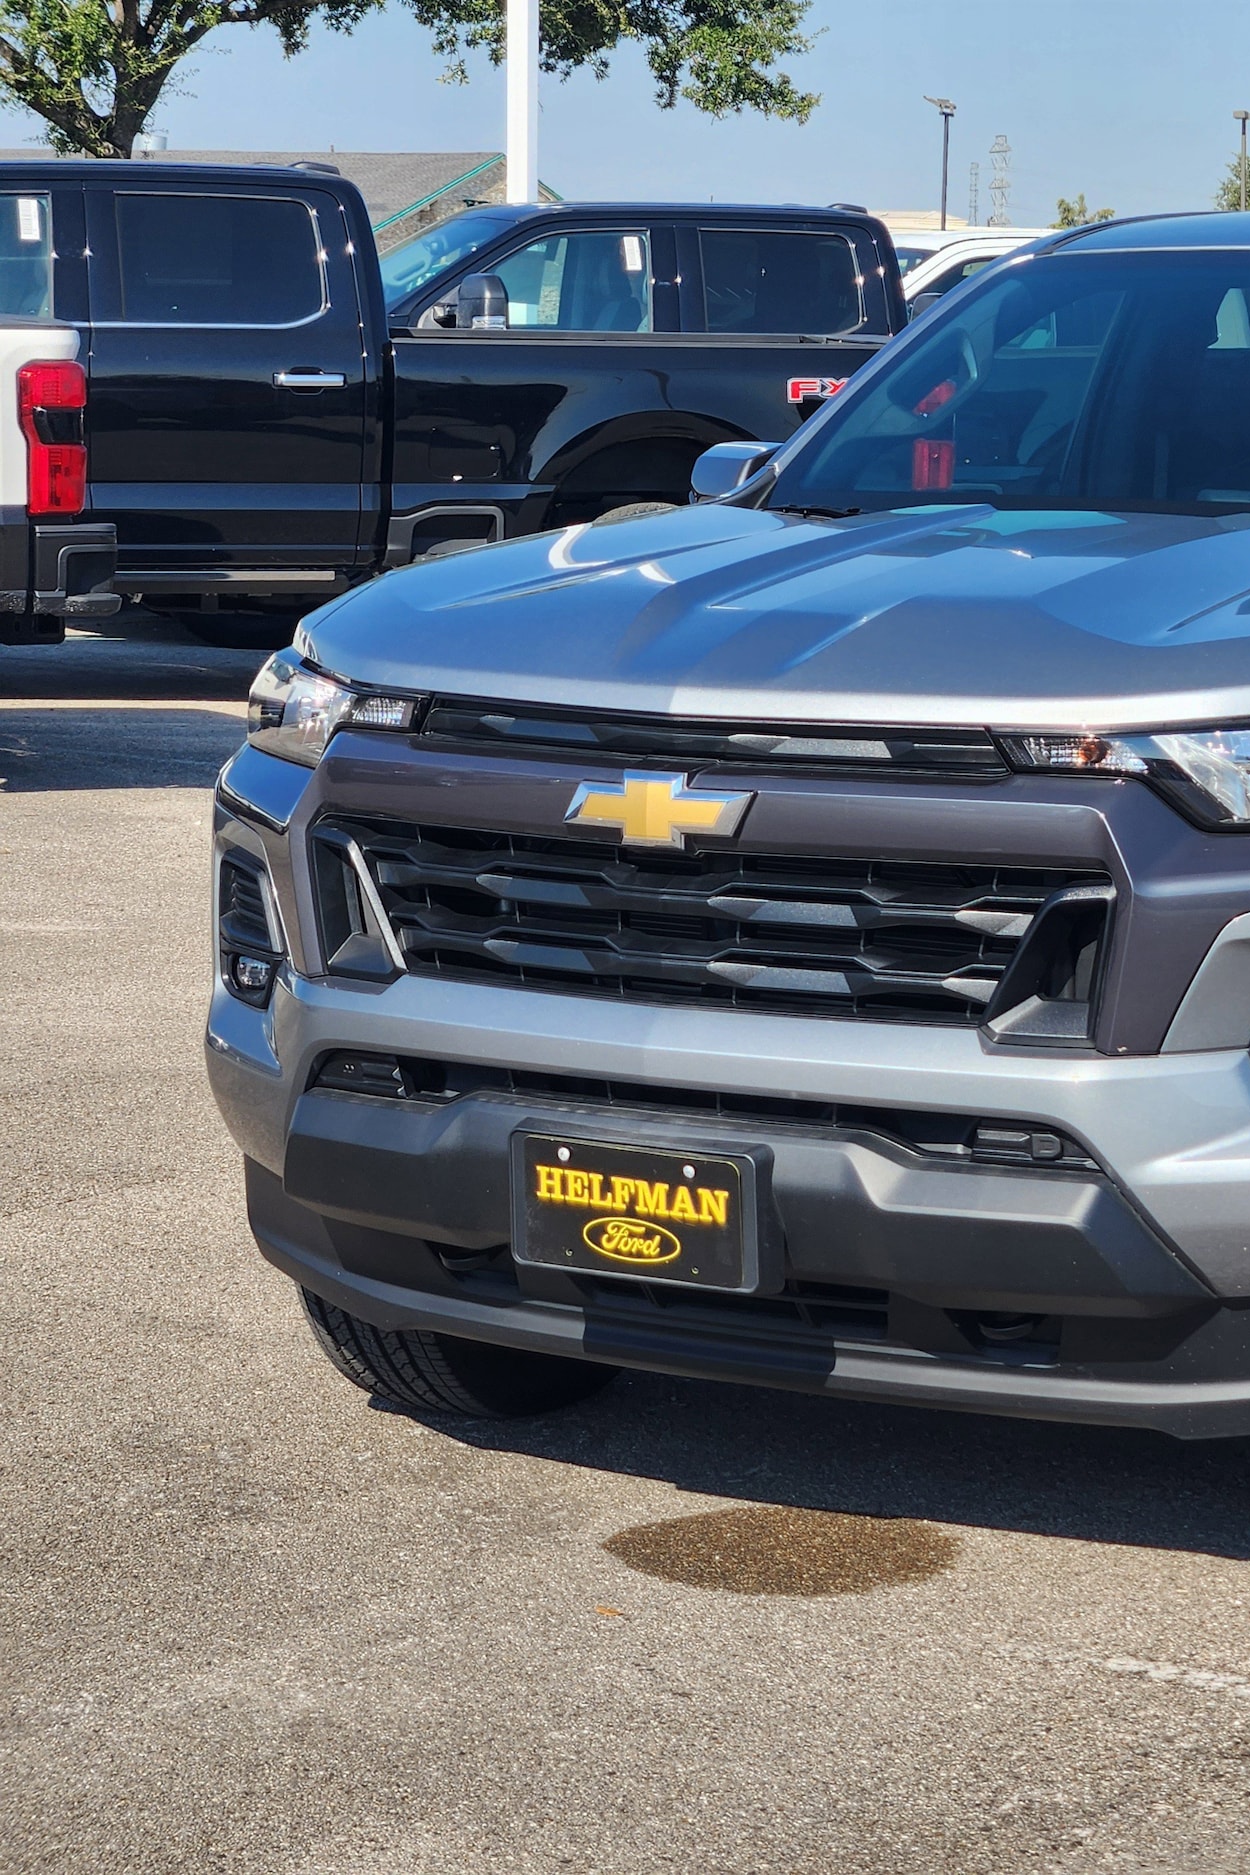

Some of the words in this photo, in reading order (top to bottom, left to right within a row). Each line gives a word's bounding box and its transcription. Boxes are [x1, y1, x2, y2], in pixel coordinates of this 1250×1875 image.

[787, 377, 850, 403] FX
[535, 1164, 729, 1225] HELFMAN
[601, 1220, 661, 1256] Ford
